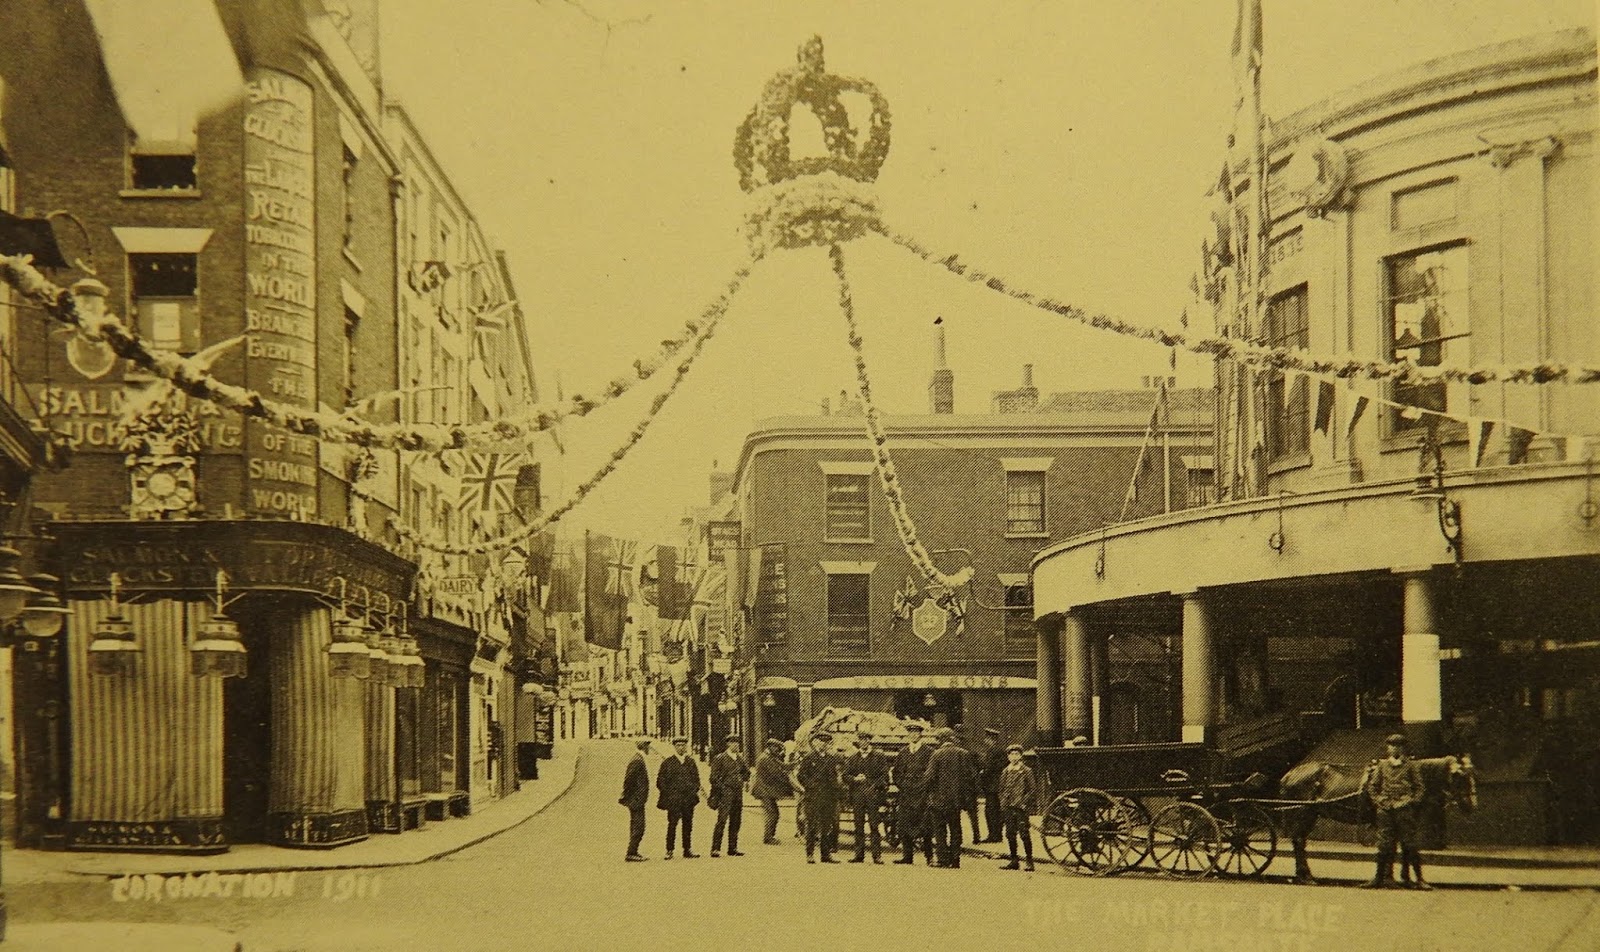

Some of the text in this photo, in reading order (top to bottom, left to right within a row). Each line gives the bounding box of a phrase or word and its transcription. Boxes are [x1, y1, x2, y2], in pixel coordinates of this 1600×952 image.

[251, 191, 313, 228] RETA
[247, 309, 314, 341] BRANC
[247, 335, 314, 366] EVERY
[39, 386, 188, 416] SALMN
[269, 378, 307, 398] THE
[263, 434, 313, 457] OF THE
[253, 488, 316, 514] WORLD
[439, 580, 473, 594] DAIRY
[949, 676, 1009, 689] SONS
